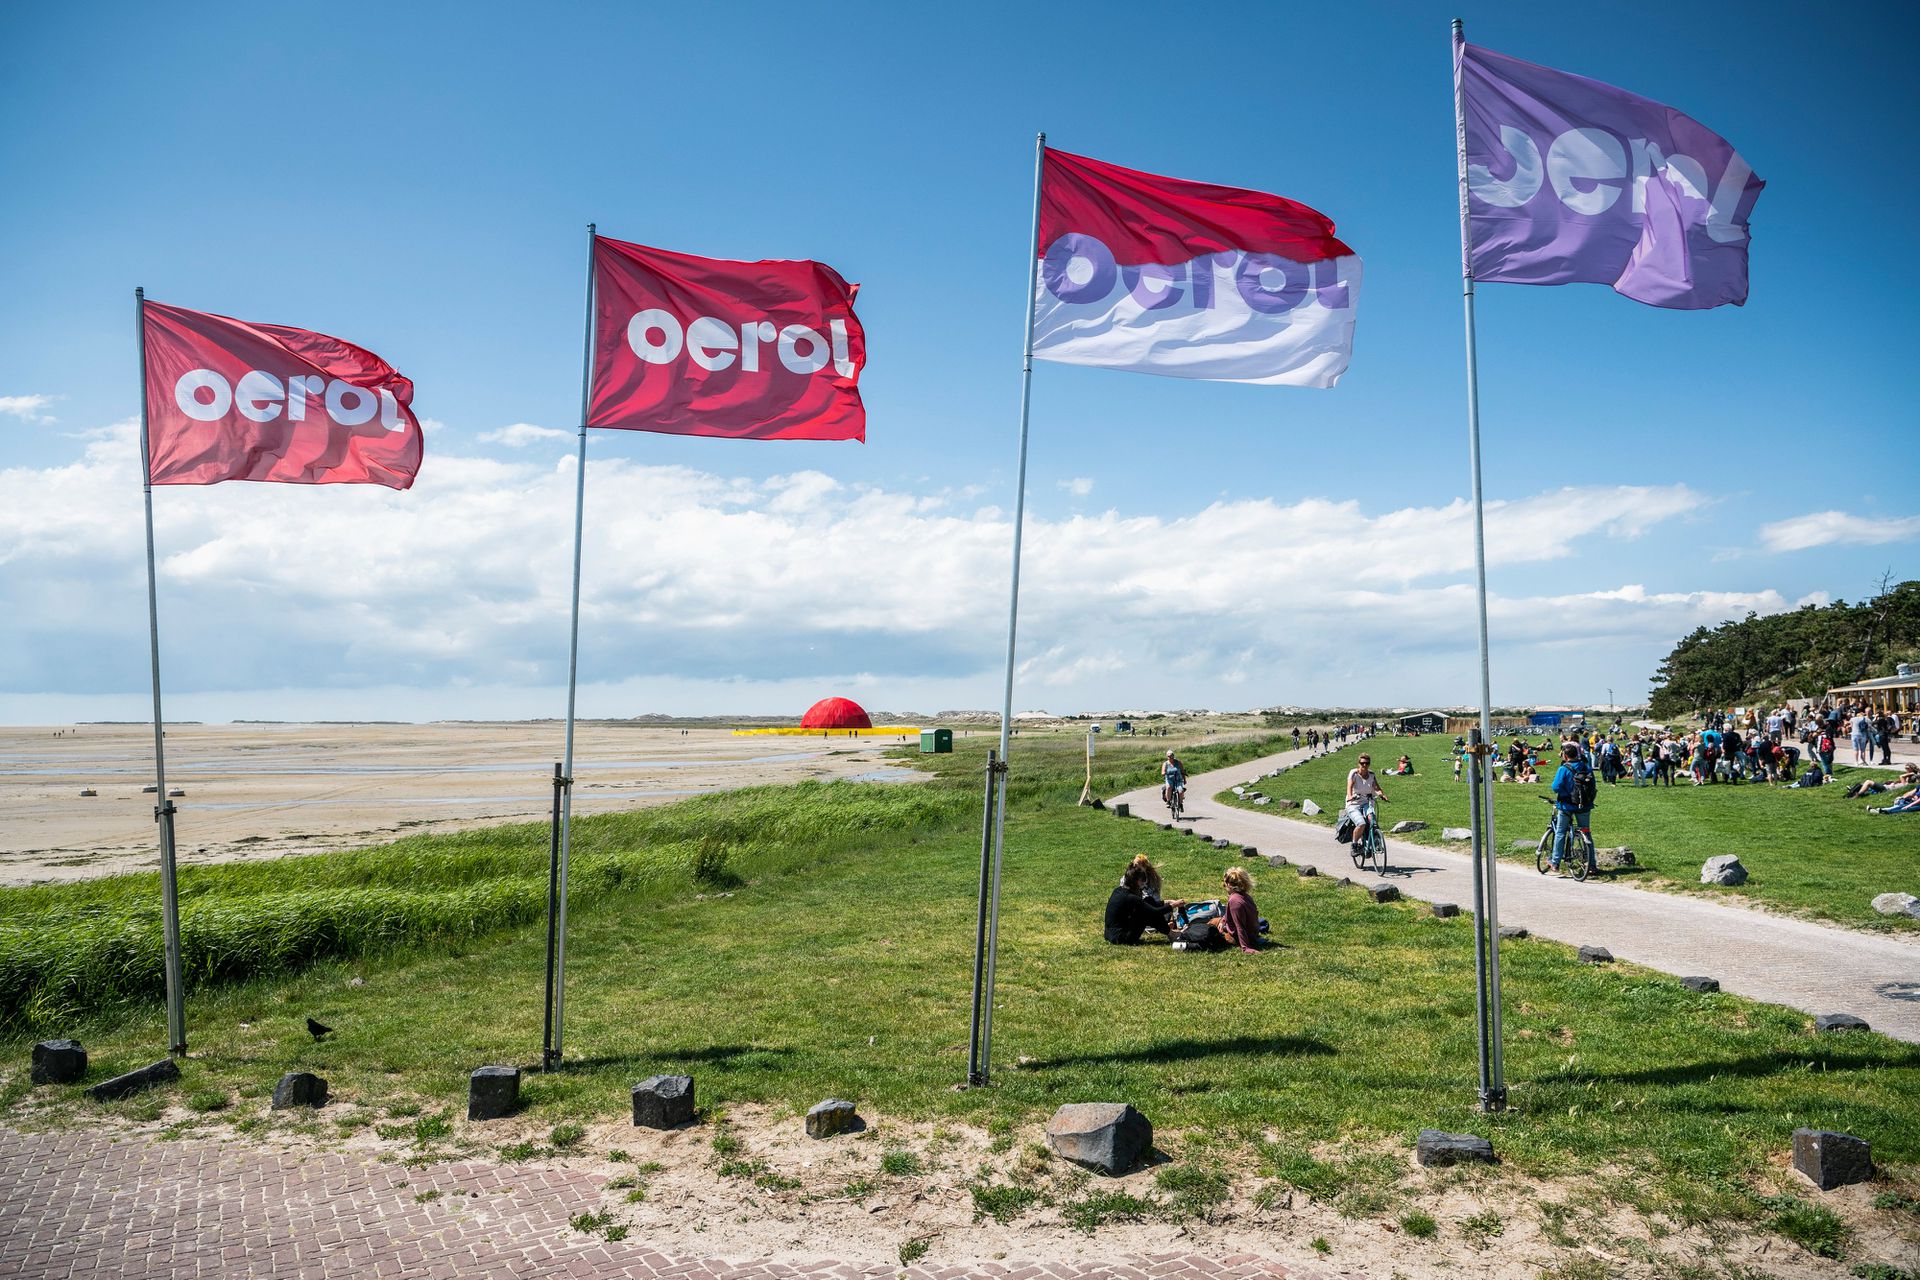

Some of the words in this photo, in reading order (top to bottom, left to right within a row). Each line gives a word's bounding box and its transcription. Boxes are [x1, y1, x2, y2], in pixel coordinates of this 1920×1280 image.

[1042, 232, 1349, 314] oerol
[627, 308, 855, 379] oerol
[175, 369, 405, 432] oerol
